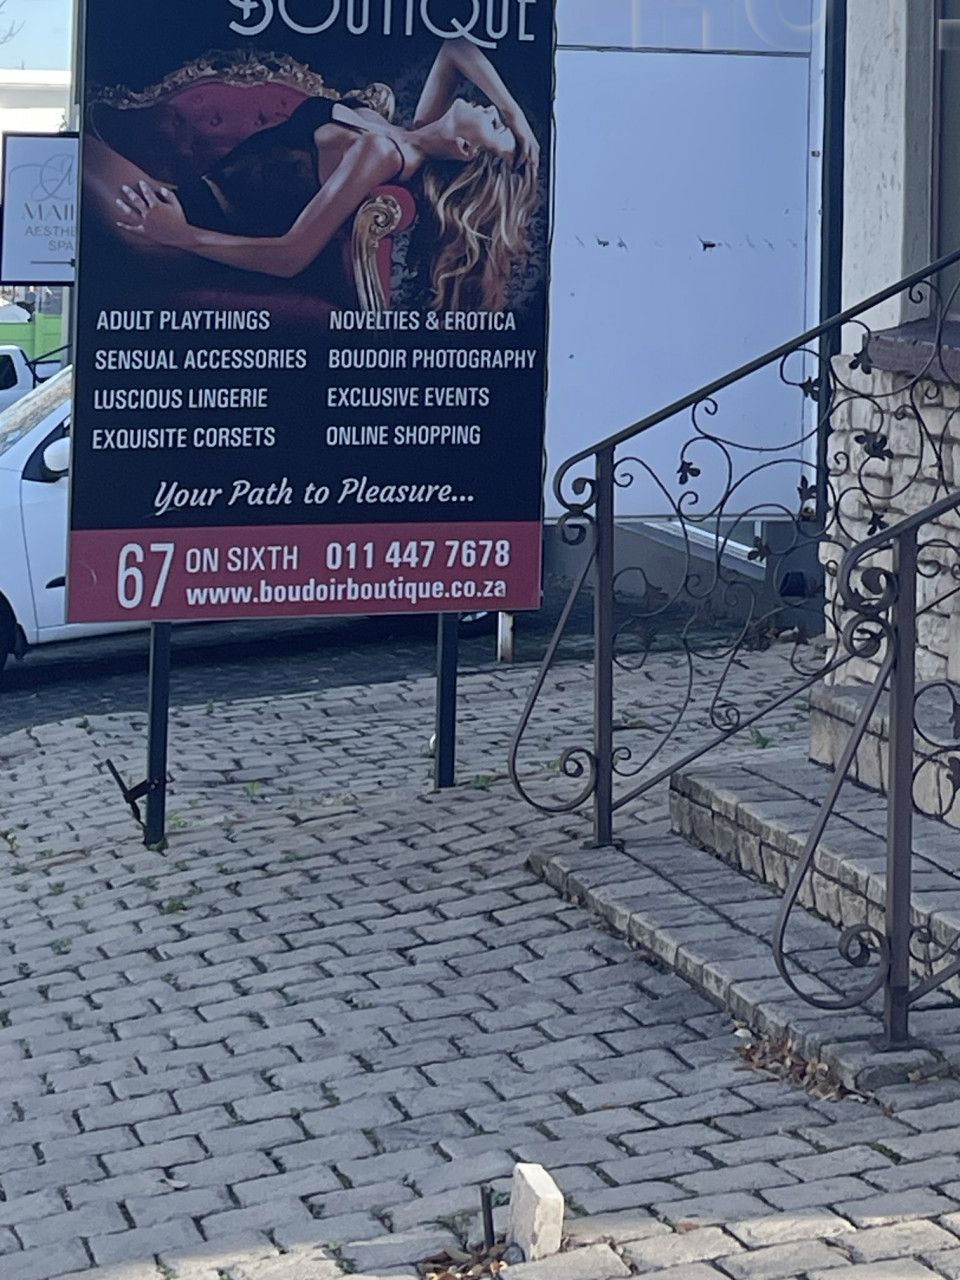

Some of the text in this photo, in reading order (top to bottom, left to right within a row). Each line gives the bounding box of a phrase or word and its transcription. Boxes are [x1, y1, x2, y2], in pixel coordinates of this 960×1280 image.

[96, 310, 271, 331] ADULT PLAYTHINGS
[329, 310, 516, 331] NOVELTIES & EROTICA
[95, 349, 307, 370] SENSUAL ACCESSORIES
[328, 349, 537, 369] BOUDOIR PHOTOGRAPHY
[93, 388, 268, 410] LUSCIOUS LINGERIE
[327, 387, 490, 407] EXCLUSIVE EVENTS
[92, 427, 276, 450] EXQUISITE CORSETS
[326, 425, 481, 446] ONLINE SHOPPING
[153, 476, 475, 516] Your Path to Pleasure...
[325, 539, 511, 570] 011 447 7678
[116, 542, 299, 609] 67 ON SIXTH
[185, 576, 507, 606] www.boudoirboutique.co.za
